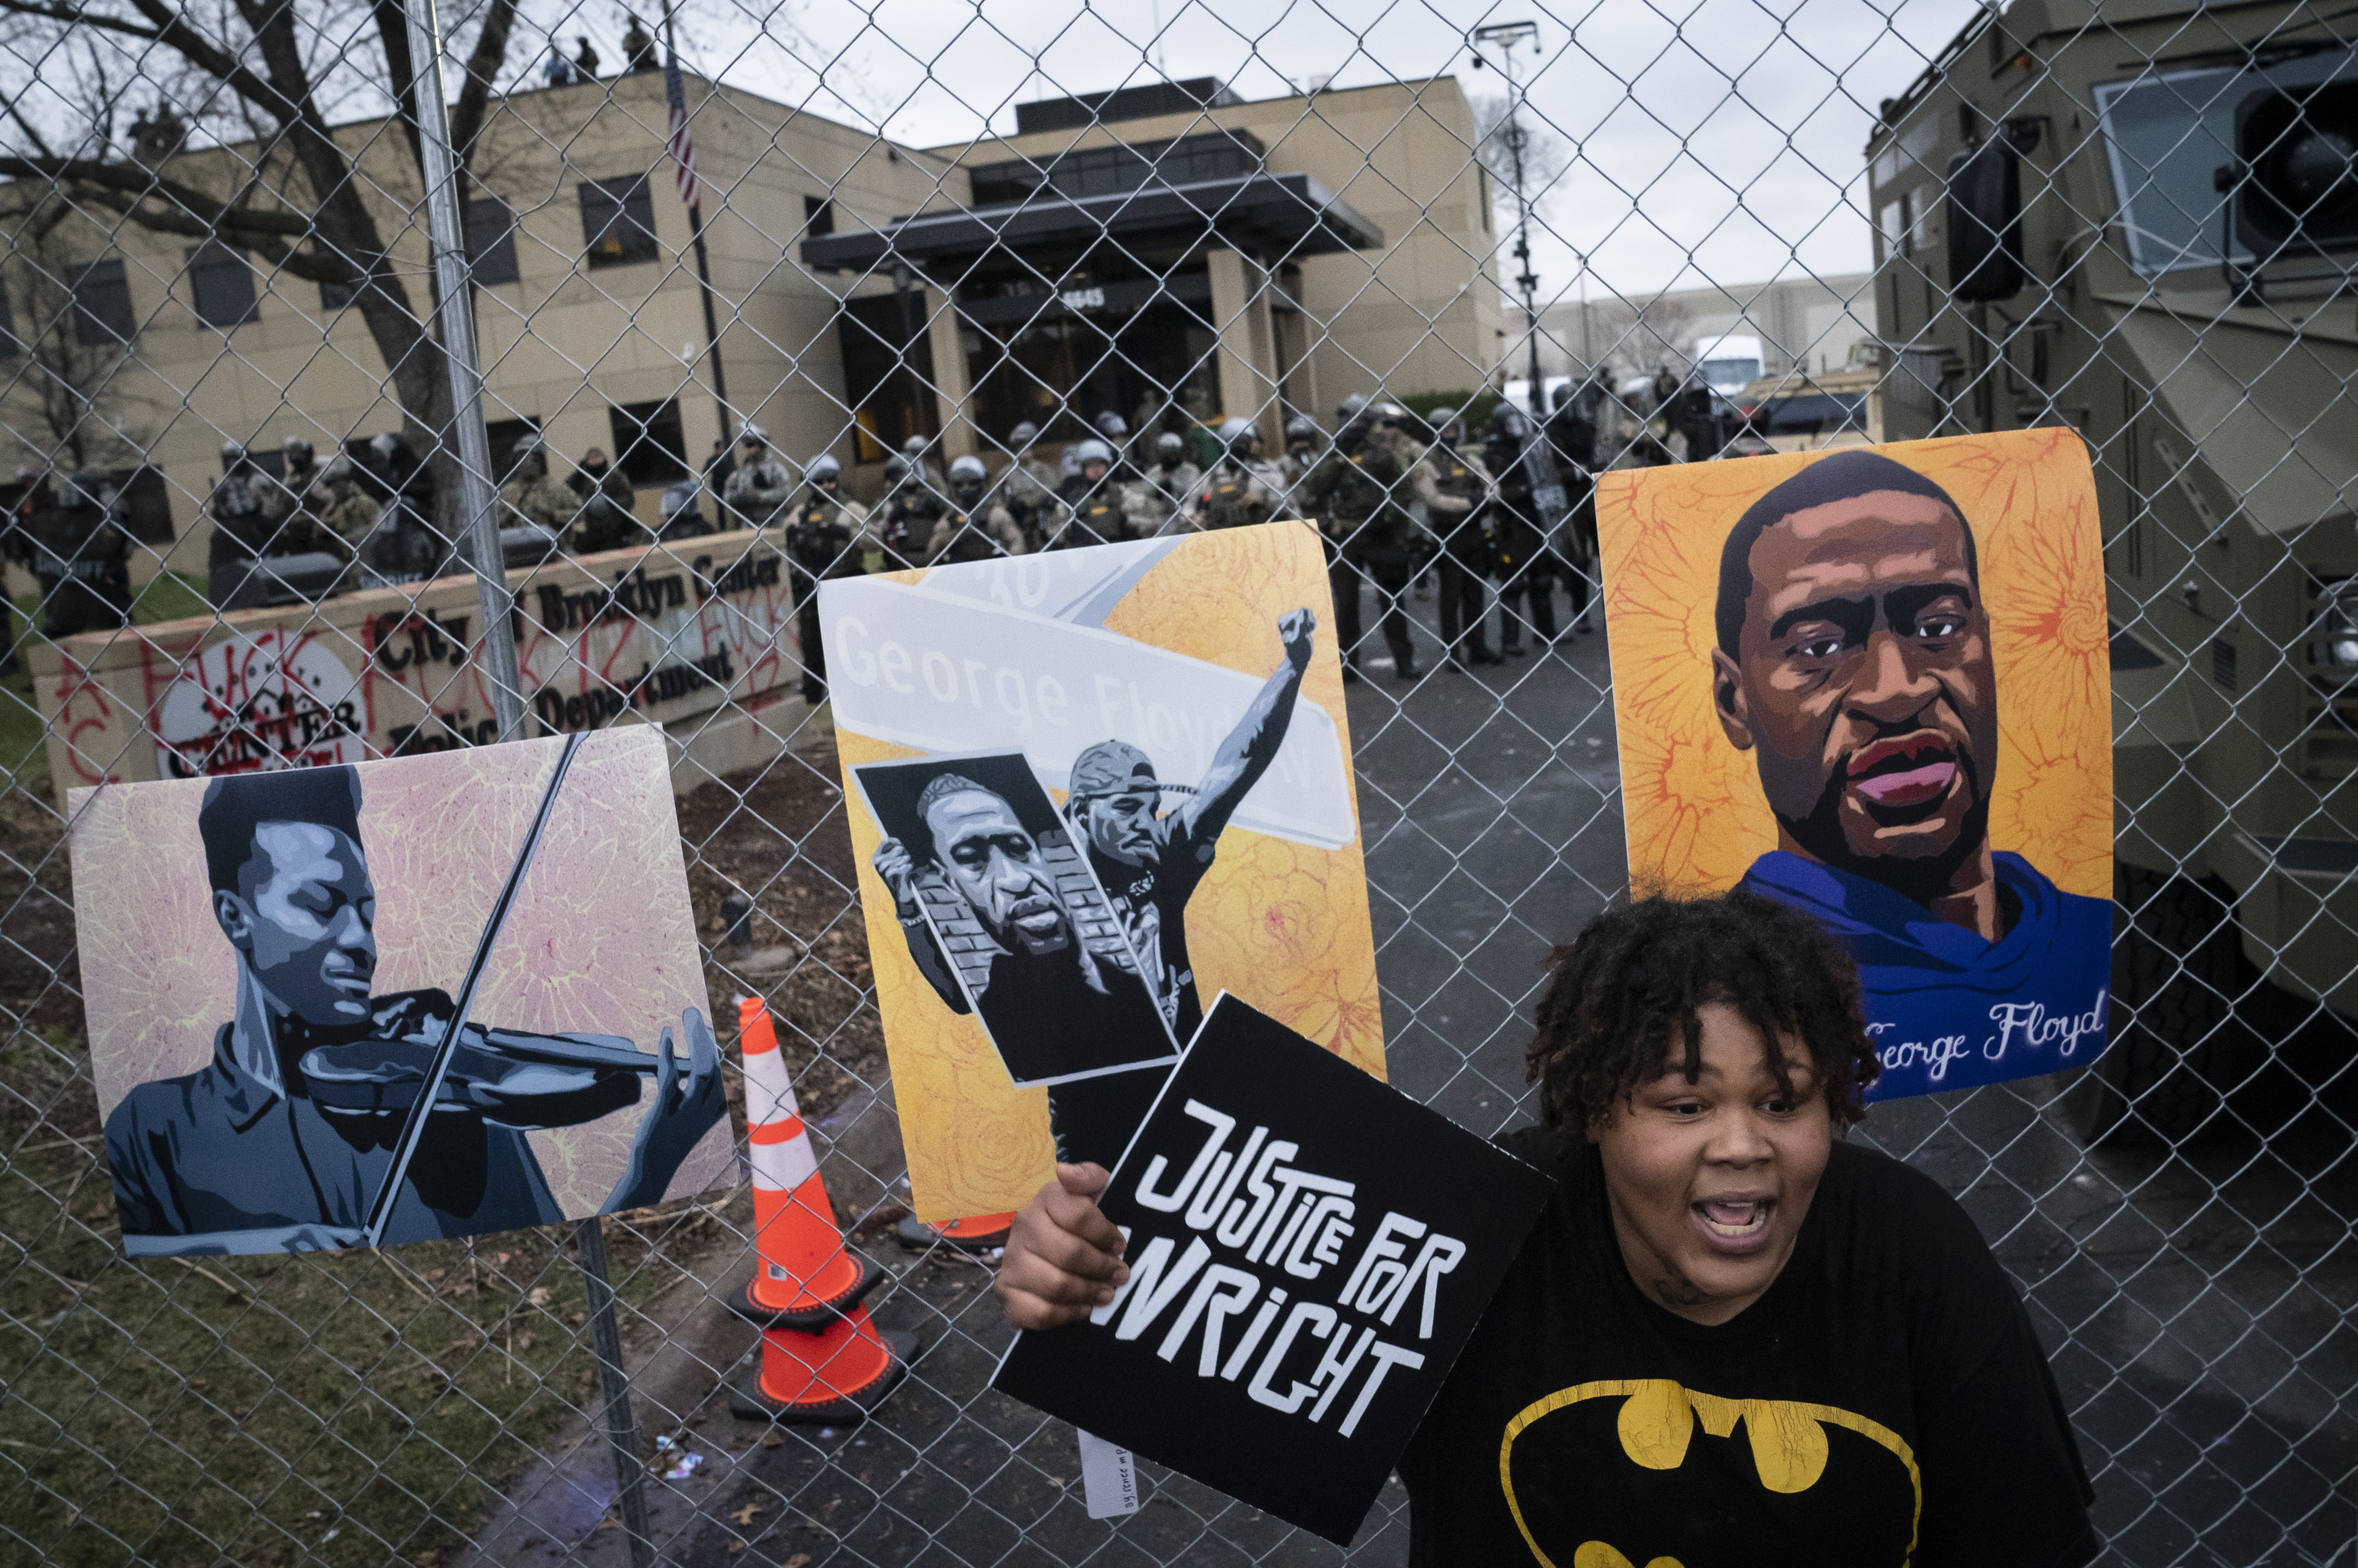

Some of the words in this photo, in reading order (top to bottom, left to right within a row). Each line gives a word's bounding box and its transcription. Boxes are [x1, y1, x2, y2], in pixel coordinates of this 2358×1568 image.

[374, 608, 469, 672] City
[537, 567, 686, 633] Brooklyn
[693, 551, 782, 600] Center
[389, 708, 501, 756] Polic
[535, 640, 735, 736] Department
[835, 615, 1071, 735] George
[1862, 1021, 1971, 1087] eorge
[1983, 987, 2107, 1061] Floyd
